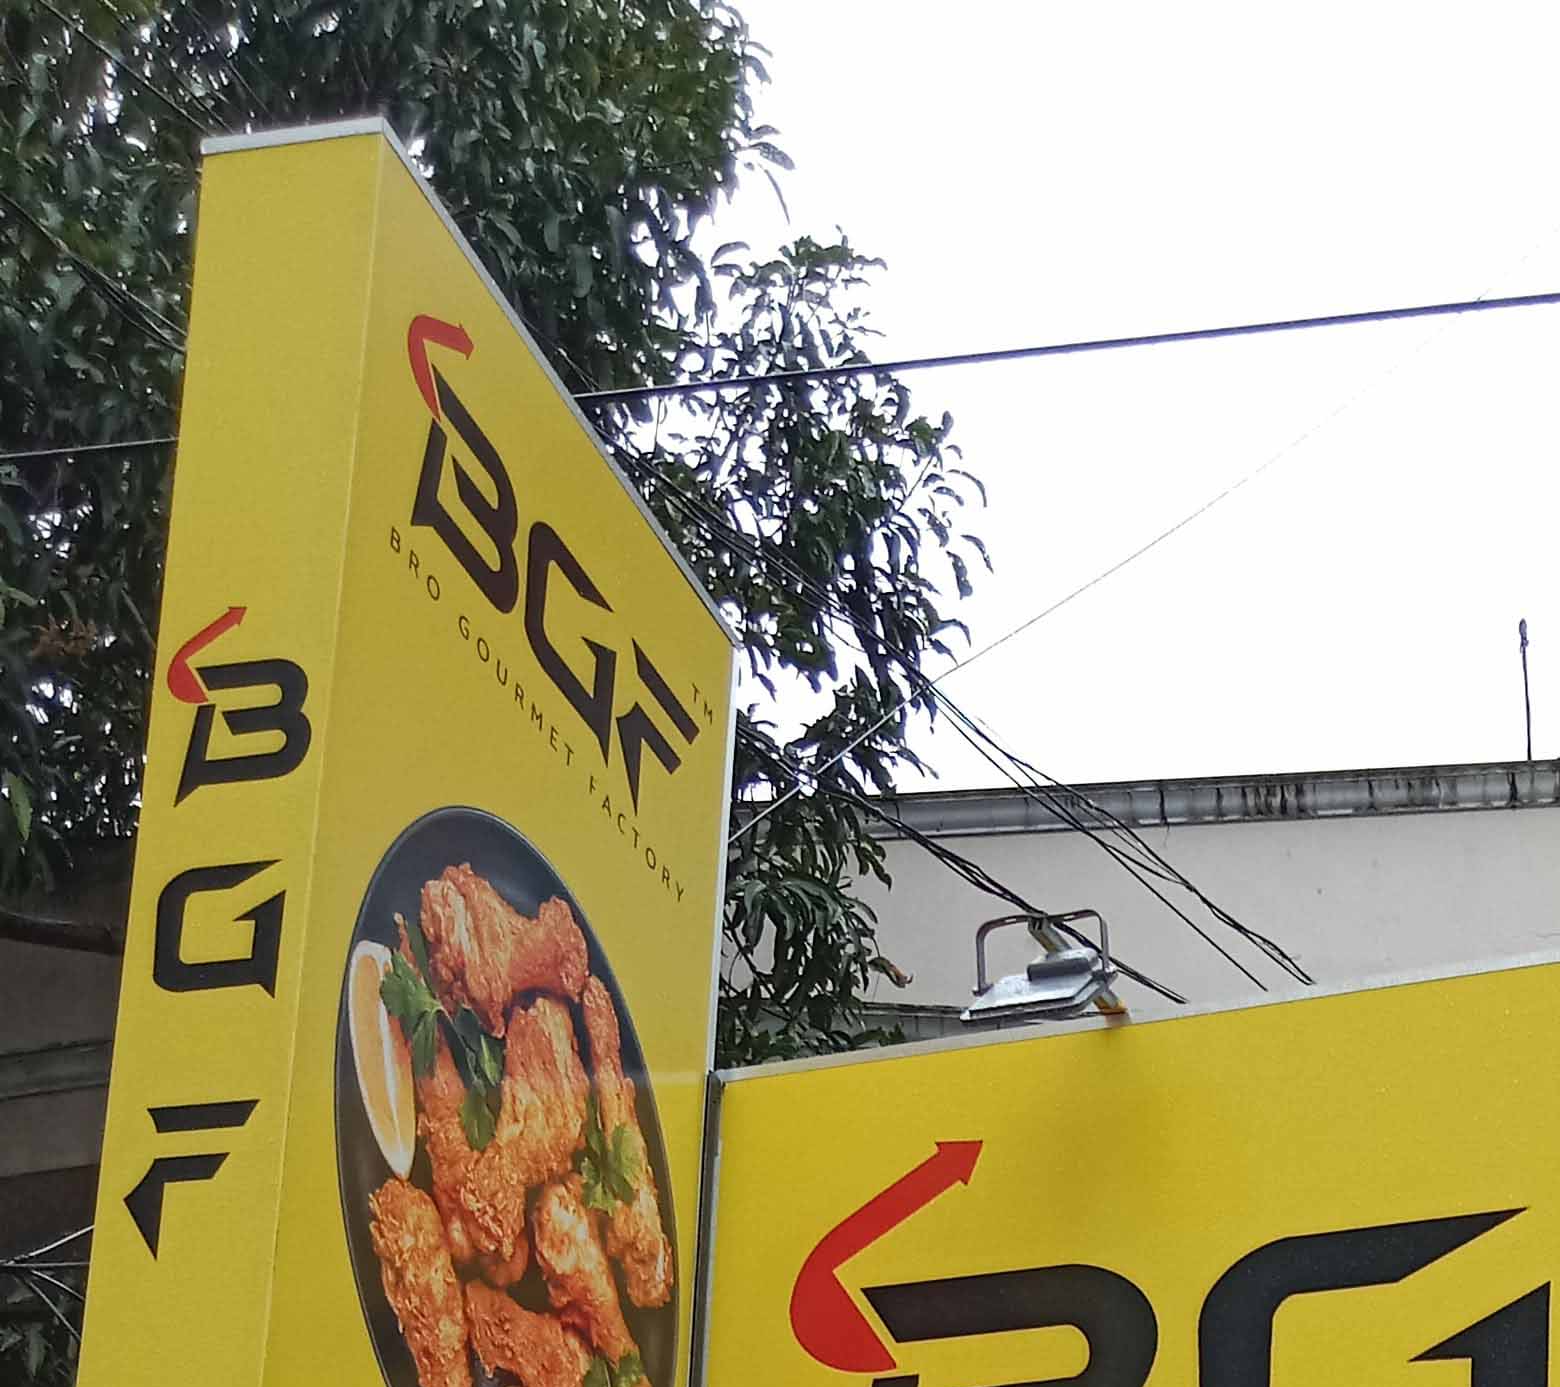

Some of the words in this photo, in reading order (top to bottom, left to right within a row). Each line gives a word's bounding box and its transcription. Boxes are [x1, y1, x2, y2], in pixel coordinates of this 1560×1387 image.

[389, 526, 441, 602] BRO
[459, 614, 575, 769] GOURMET
[589, 776, 686, 904] FACTORY
